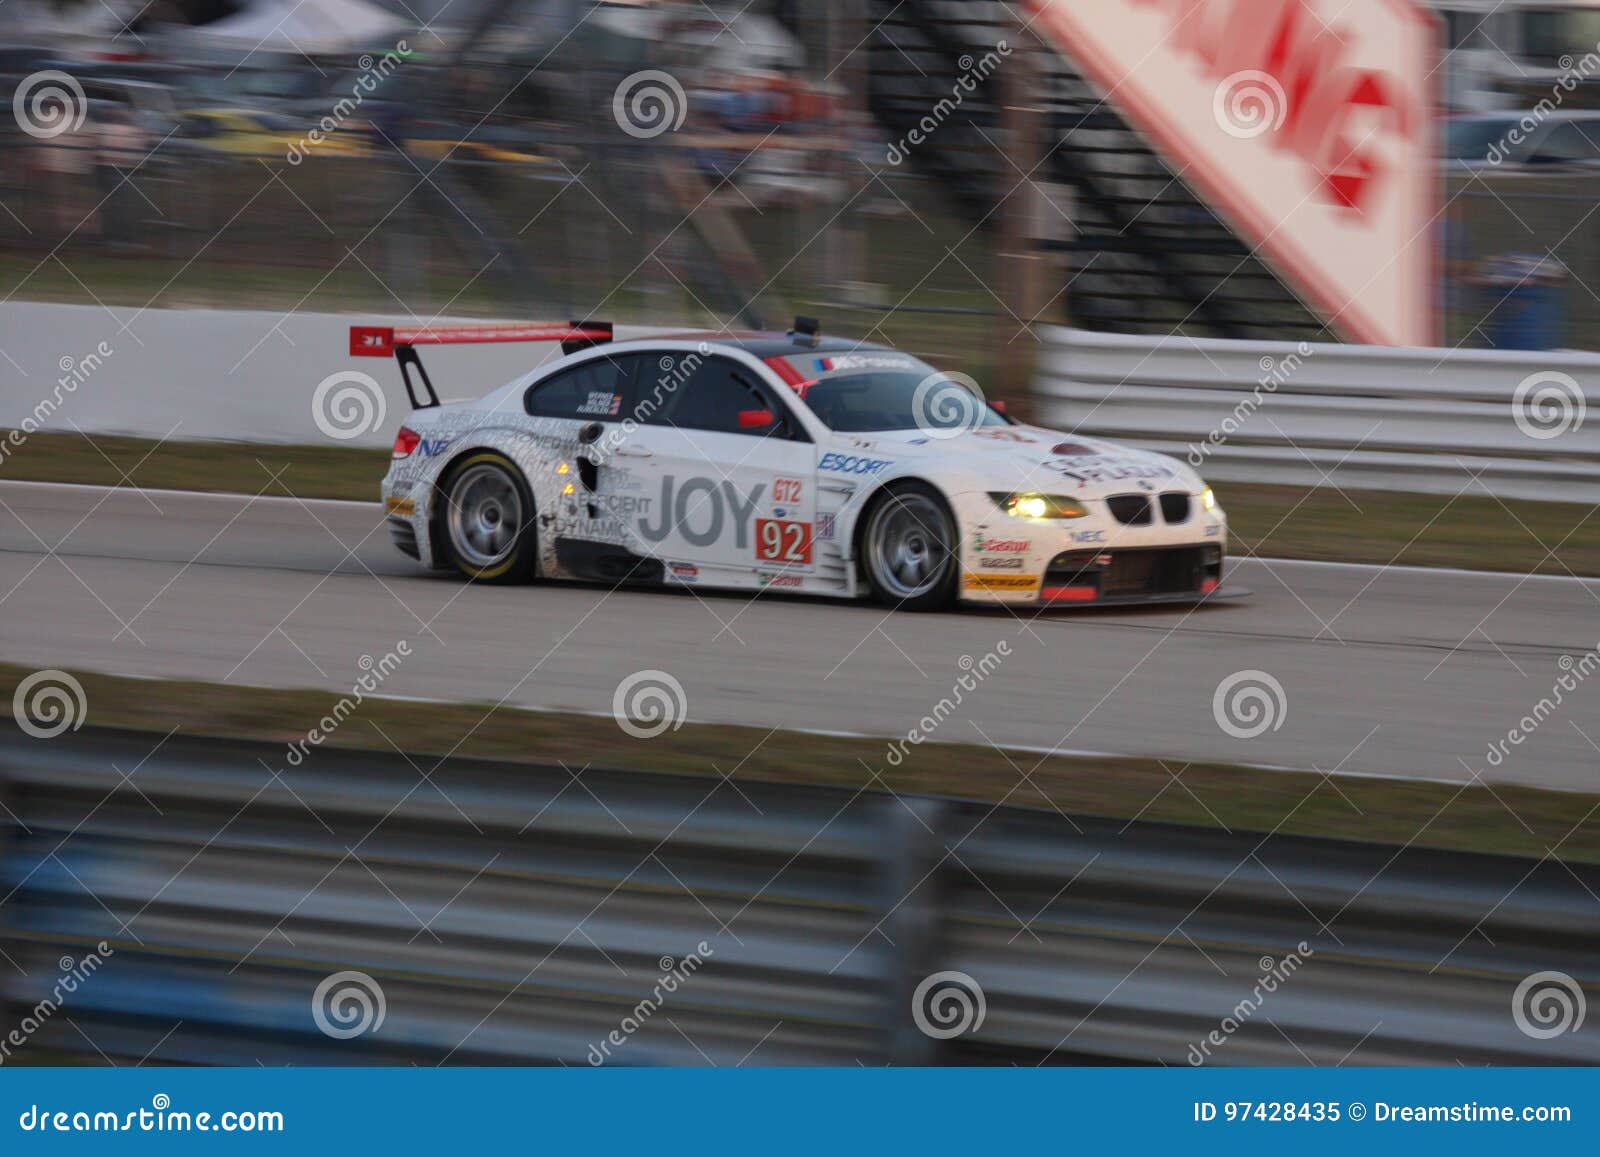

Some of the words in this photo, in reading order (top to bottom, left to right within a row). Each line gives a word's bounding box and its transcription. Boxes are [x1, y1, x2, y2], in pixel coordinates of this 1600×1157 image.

[817, 453, 896, 474] ESCORT
[773, 479, 802, 503] GT2
[638, 475, 767, 549] JOY
[762, 521, 806, 561] 92
